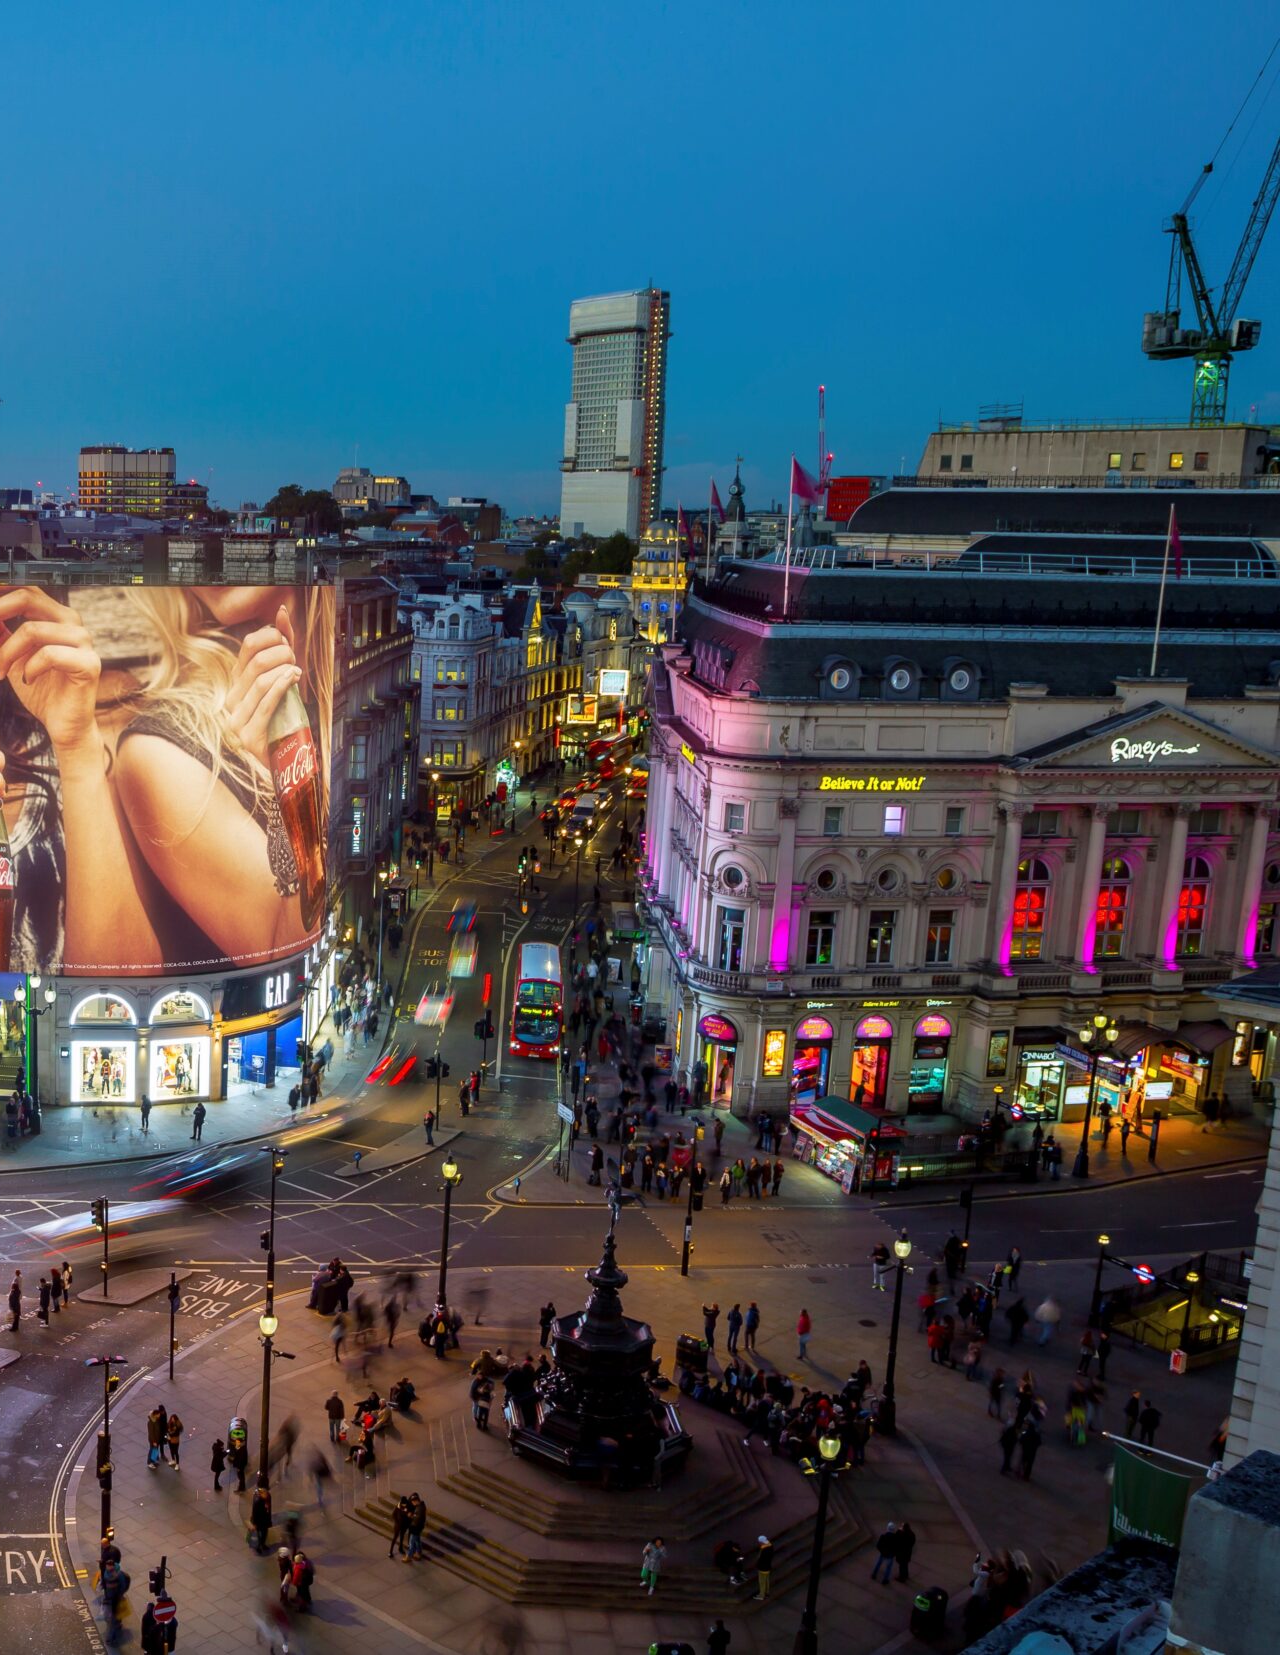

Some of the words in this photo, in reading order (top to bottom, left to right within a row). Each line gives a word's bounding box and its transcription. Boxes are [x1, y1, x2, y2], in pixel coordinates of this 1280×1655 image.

[820, 776, 865, 790] Believe
[866, 777, 879, 791] It
[880, 779, 895, 791] or
[895, 777, 924, 791] Not!
[418, 949, 445, 957] BUS
[265, 972, 290, 1009] GAP
[187, 1274, 264, 1301] LANE
[179, 1294, 231, 1319] BUS
[73, 1599, 92, 1622] WAYS
[84, 1626, 104, 1650] BOTH
